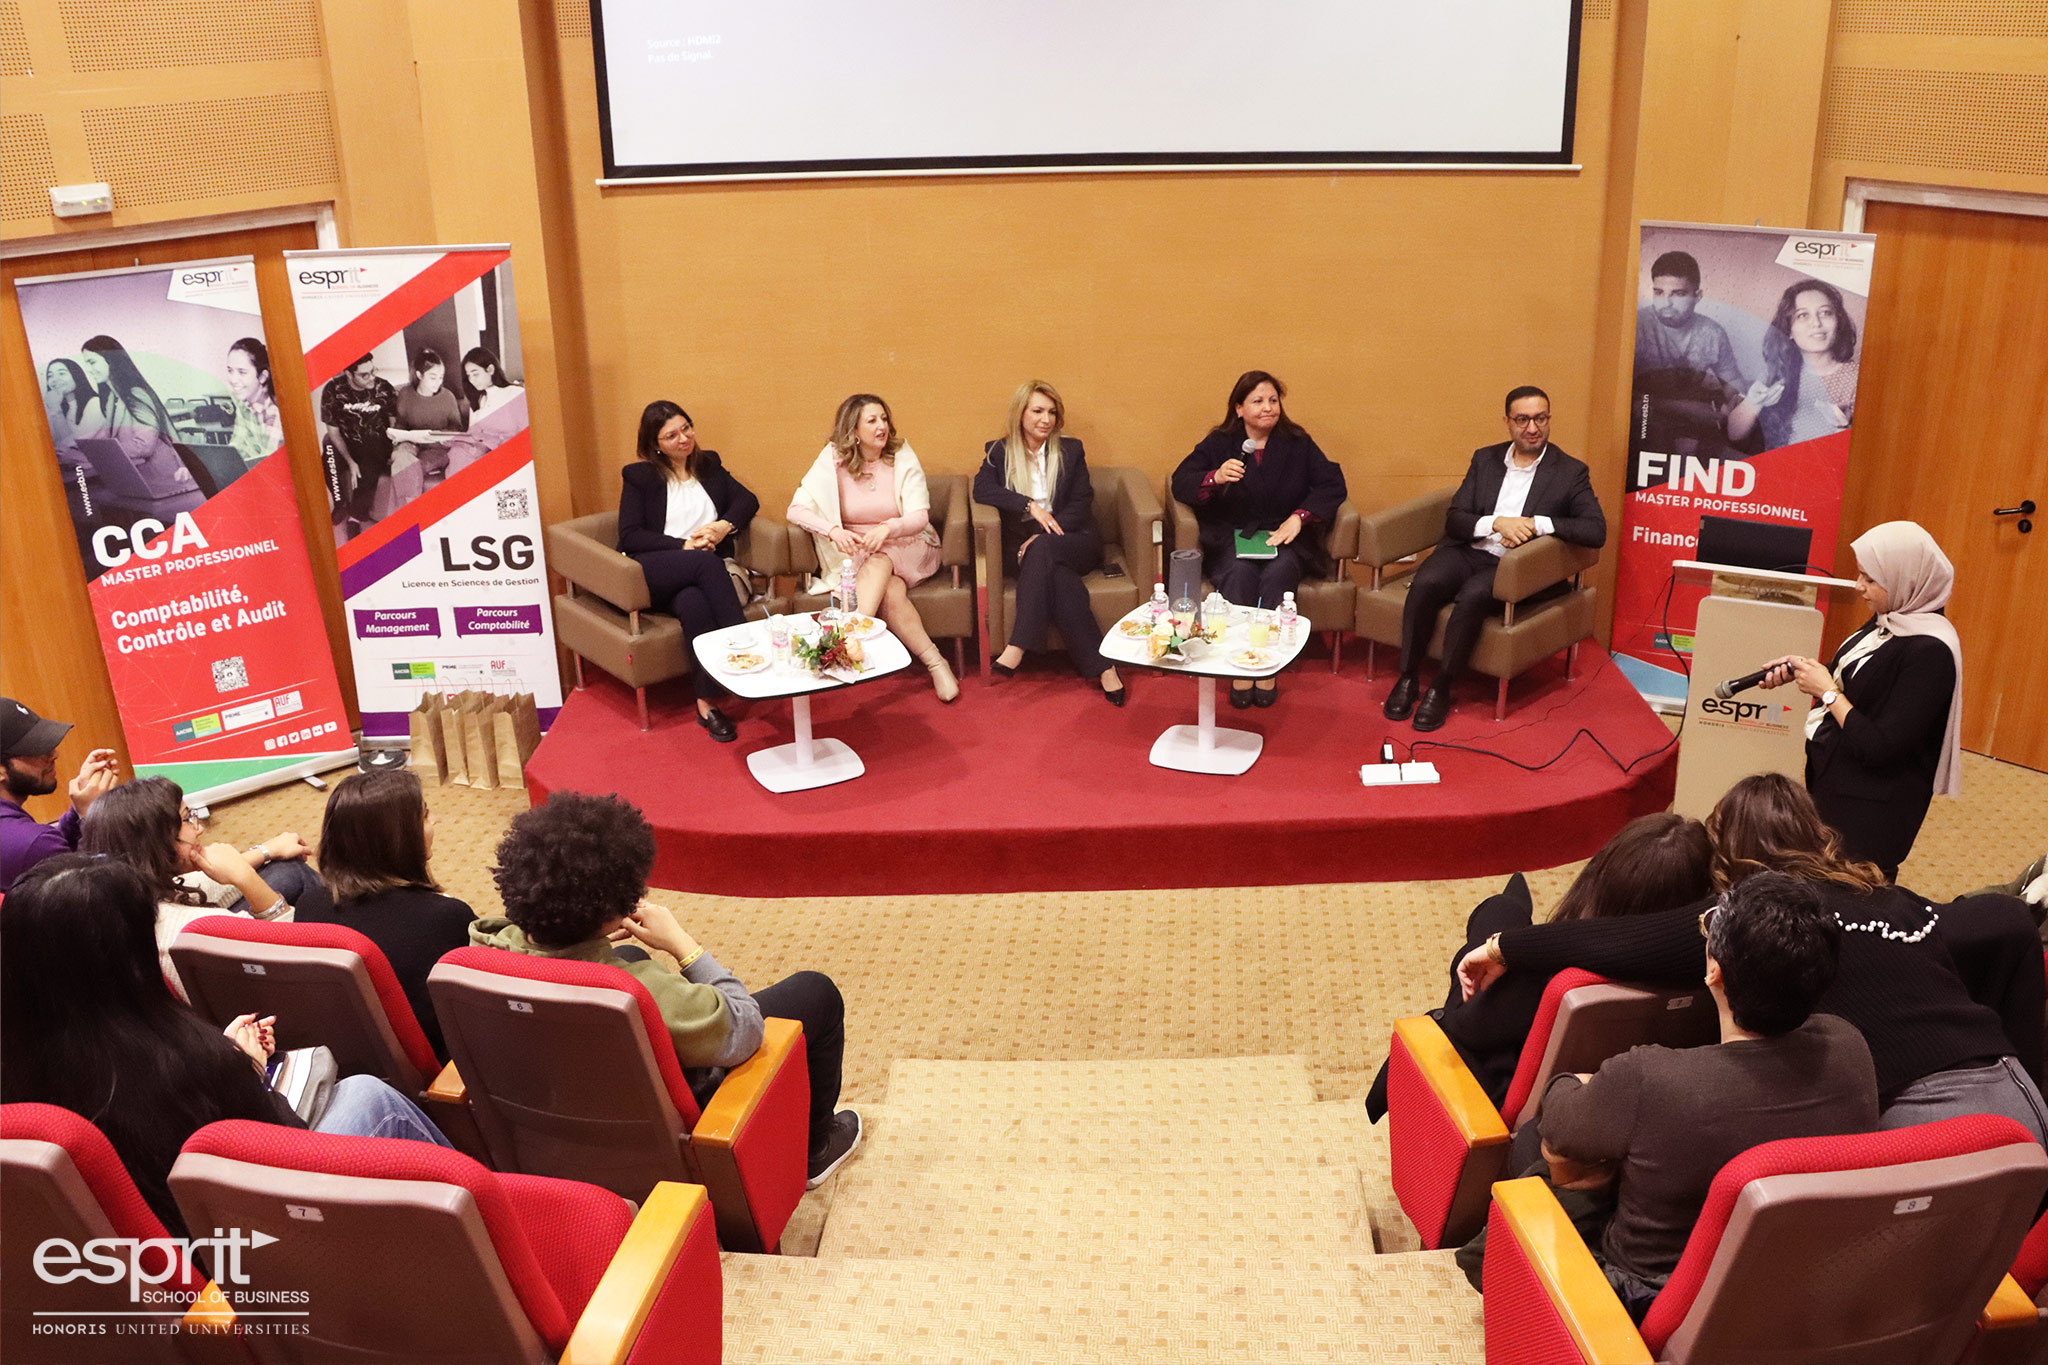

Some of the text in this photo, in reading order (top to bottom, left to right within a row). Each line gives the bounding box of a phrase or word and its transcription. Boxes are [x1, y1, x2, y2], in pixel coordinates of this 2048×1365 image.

[647, 39, 680, 49] Source
[687, 34, 721, 46] HDMI2
[647, 54, 666, 64] Pas
[667, 52, 680, 62] de
[1795, 241, 1849, 259] esprit
[299, 267, 361, 289] esprit
[1641, 393, 1650, 440] www.esb.tn
[326, 444, 341, 502] www.esb.tn
[1637, 451, 1756, 497] FIND
[75, 465, 93, 517] www.esb.tn
[1635, 491, 1808, 522] MASTER PROFESSIONNEL
[92, 511, 209, 567] CCA
[440, 534, 535, 572] LSG
[100, 539, 279, 587] MASTER PROFESSIONNEL
[402, 580, 436, 589] Licence
[451, 579, 490, 587] Sciences
[492, 578, 503, 586] de
[505, 576, 540, 586] Gestion
[111, 584, 249, 629] Comptabilité,
[476, 607, 518, 618] Parcours
[374, 611, 417, 621] Parcours
[117, 600, 287, 654] Contrôle et Audit
[365, 622, 430, 635] Management
[467, 620, 530, 631] Comptabilité
[490, 660, 506, 669] AUF
[274, 694, 290, 708] AUF
[1702, 698, 1782, 722] esprit
[250, 965, 257, 973] 5
[517, 1002, 524, 1010] 6
[298, 1207, 306, 1217] 7
